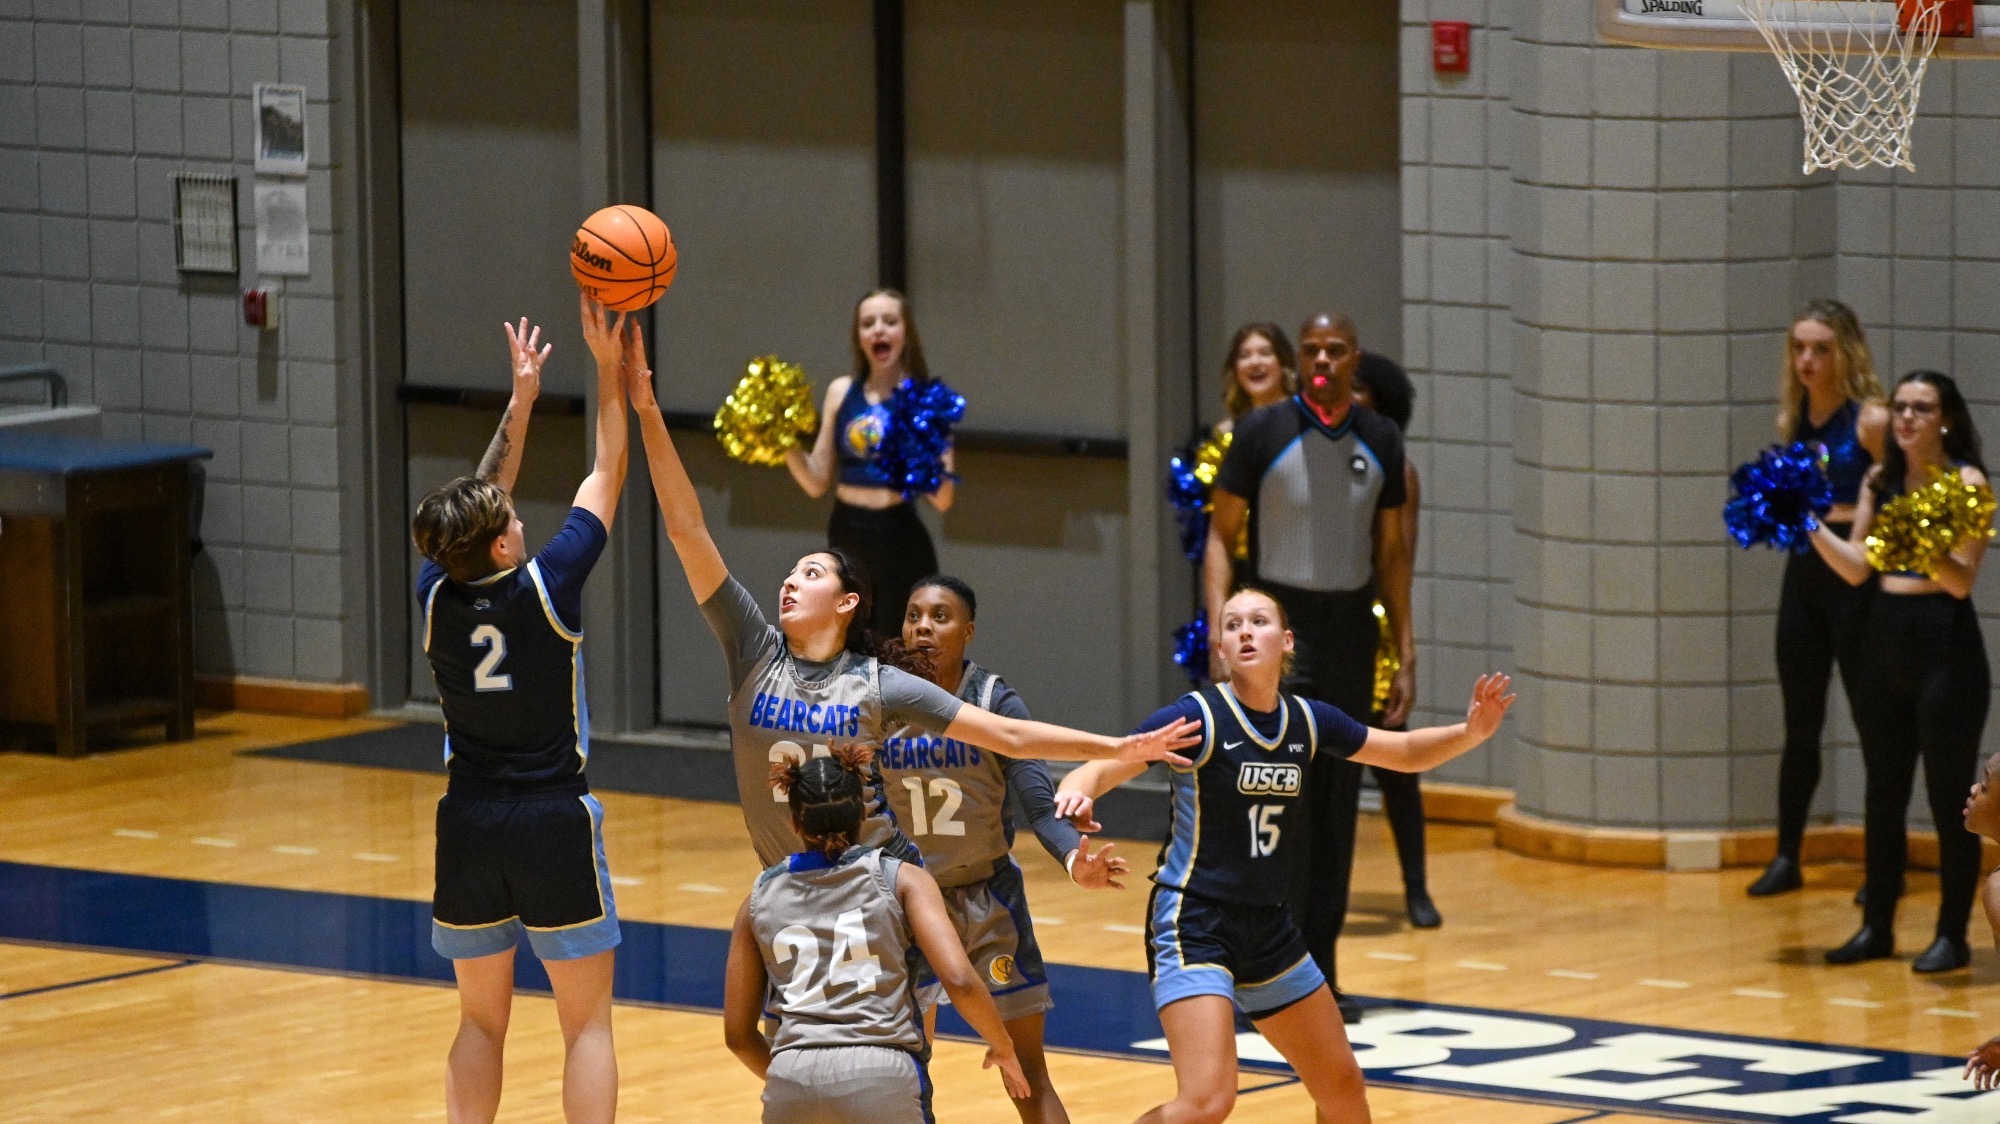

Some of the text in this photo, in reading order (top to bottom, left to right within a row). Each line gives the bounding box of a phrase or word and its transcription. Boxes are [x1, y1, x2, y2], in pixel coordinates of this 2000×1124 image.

[1642, 0, 1703, 16] SPALDING
[571, 236, 613, 273] ilson
[469, 624, 514, 692] 2
[750, 691, 861, 737] BEARCATS
[880, 733, 981, 770] BEARCATS
[1241, 766, 1299, 792] USCB
[902, 776, 966, 836] 12
[1248, 804, 1286, 858] 15
[773, 908, 882, 1012] 24
